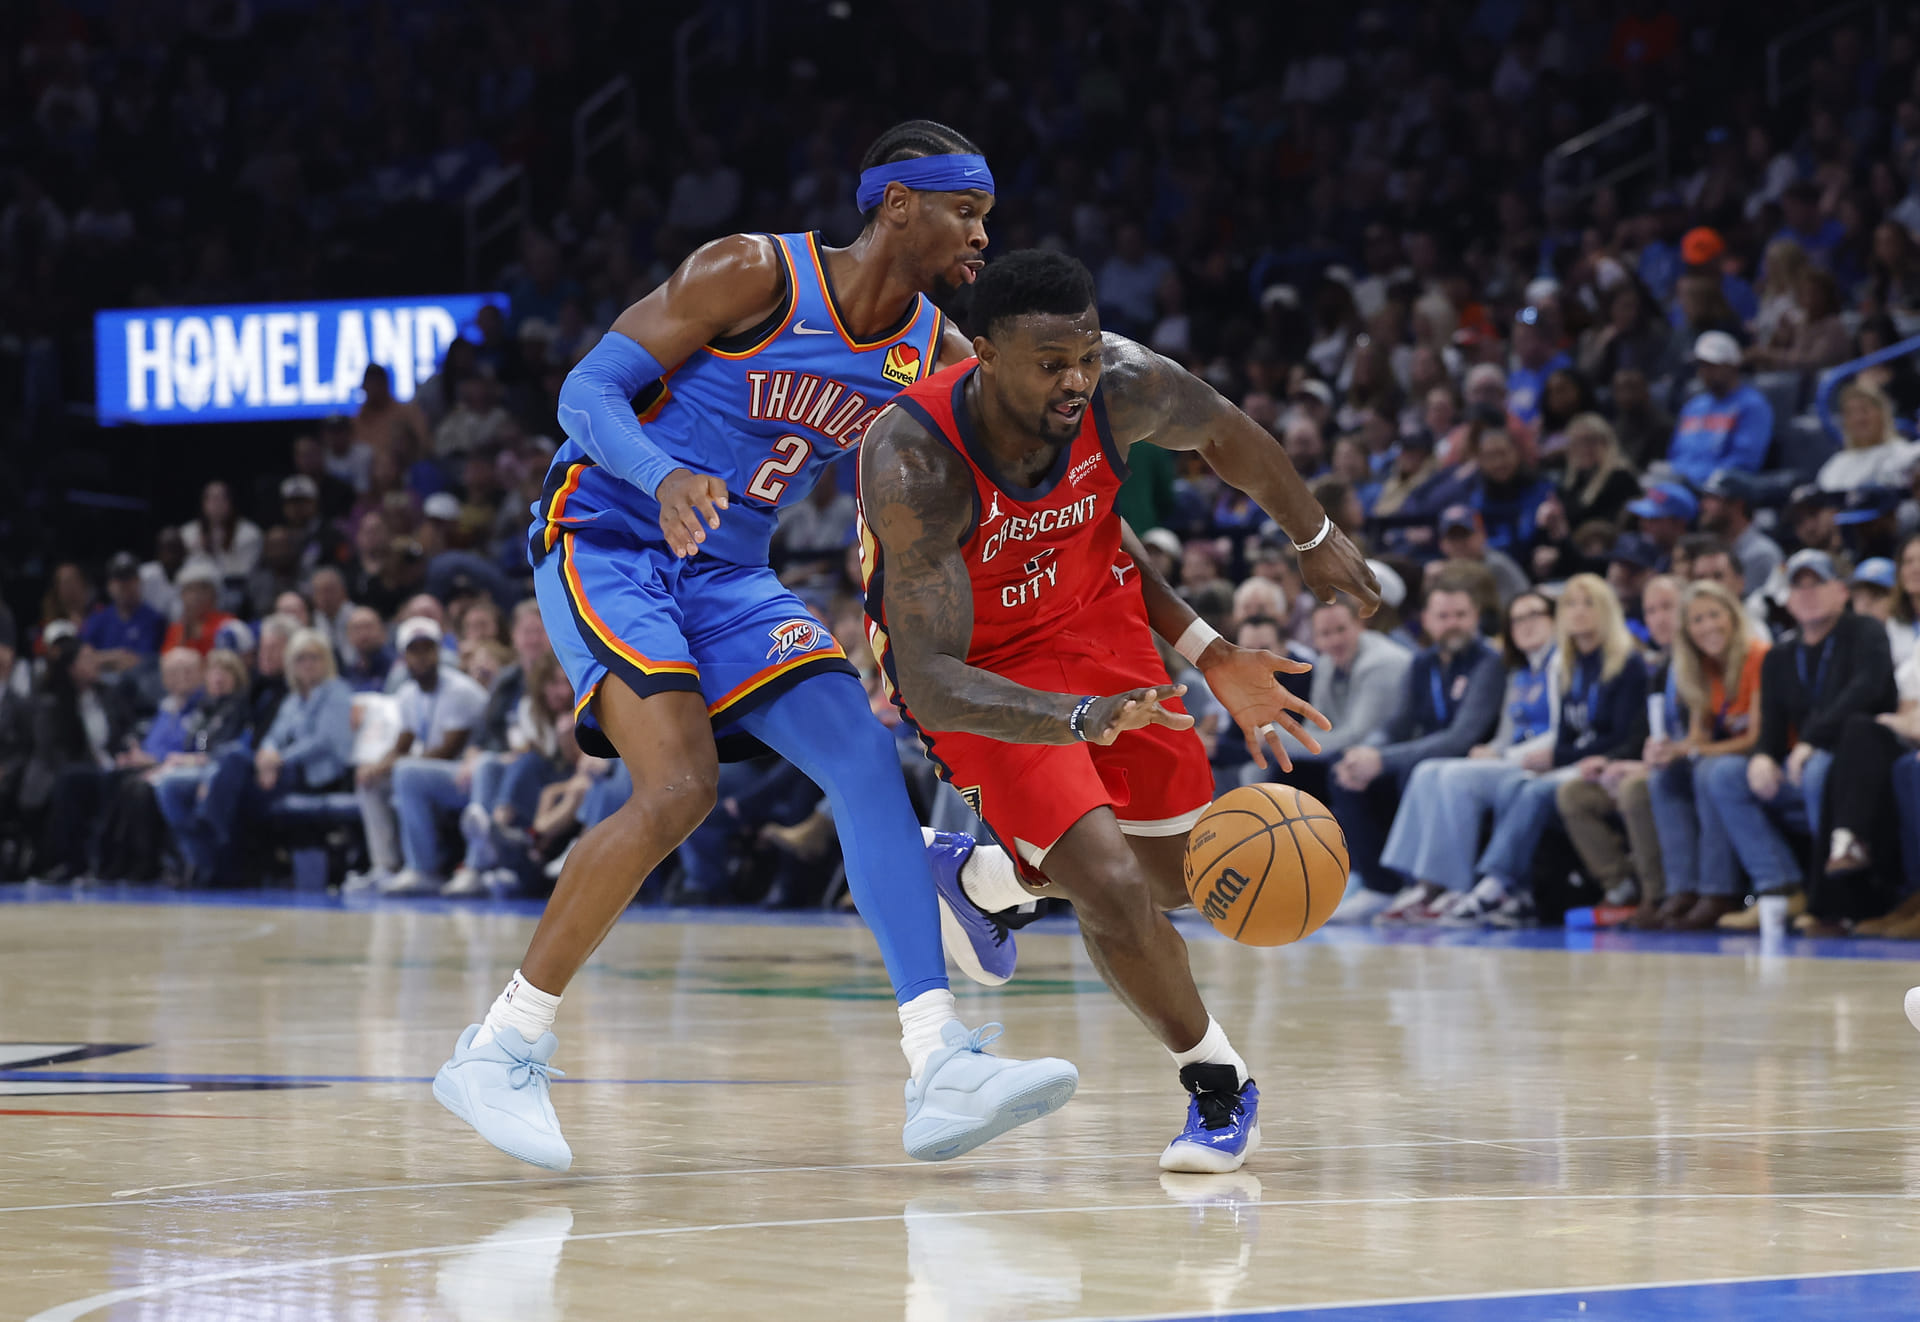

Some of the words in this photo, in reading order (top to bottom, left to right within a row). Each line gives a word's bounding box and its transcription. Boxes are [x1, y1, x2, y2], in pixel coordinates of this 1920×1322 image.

[746, 370, 879, 450] THUNDE
[745, 434, 812, 504] 2
[982, 494, 1097, 563] CRESCENT
[1001, 561, 1057, 607] CITY
[780, 624, 810, 653] OKC
[1201, 867, 1251, 926] Wil
